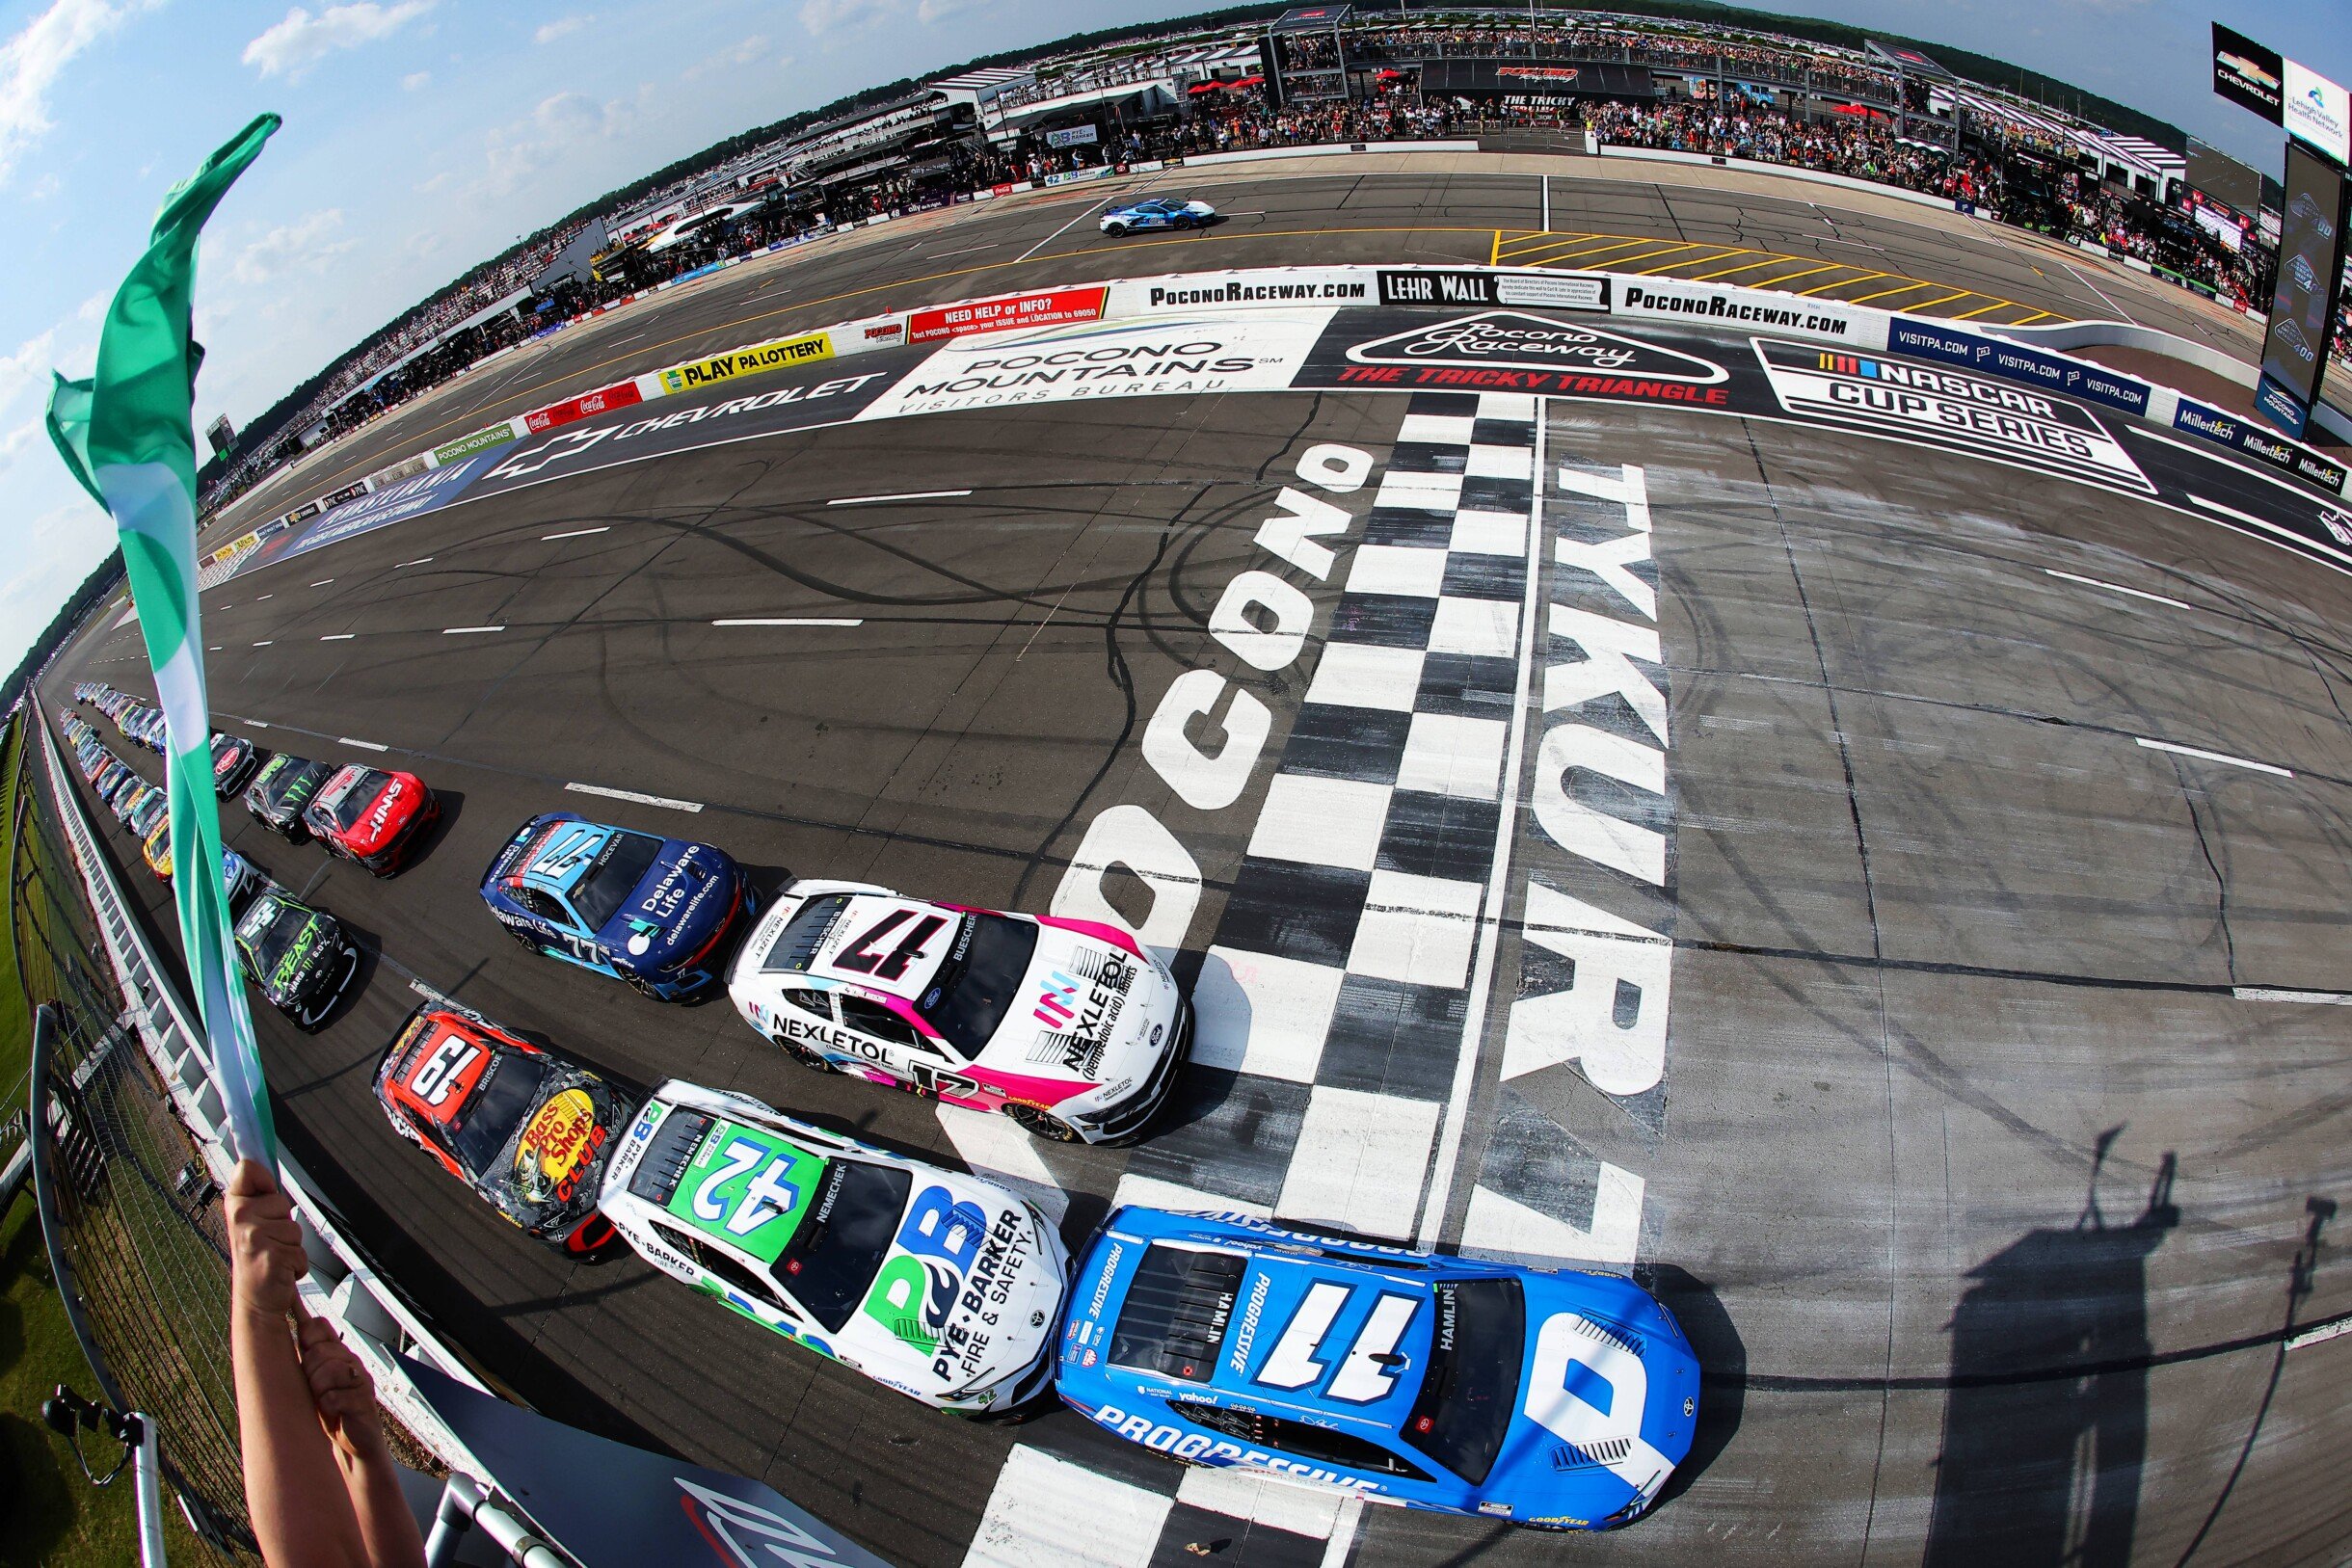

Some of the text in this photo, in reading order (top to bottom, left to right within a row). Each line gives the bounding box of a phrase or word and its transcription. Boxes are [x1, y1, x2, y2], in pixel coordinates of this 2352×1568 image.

[1504, 94, 1576, 106] THE TRICKY
[2217, 68, 2280, 107] CHEVROLET
[2287, 103, 2312, 121] Health
[2312, 115, 2343, 139] Network
[2292, 96, 2339, 128] Lehigh Valley
[1046, 175, 1060, 184] 42
[891, 208, 900, 219] 48
[2068, 234, 2080, 245] 45
[1385, 275, 1489, 302] LEHR WALL
[912, 307, 1097, 340] Text POCONO <space> your ISSUE and LOCATION to 69050
[945, 298, 1052, 324] NEED HELP or INFO?
[1404, 329, 1637, 368] Raceway
[1465, 322, 1598, 343] Pocono
[684, 357, 735, 385] PLAY
[739, 353, 761, 371] PA
[762, 339, 825, 366] LOTTERY
[962, 341, 1222, 375] POCONO
[1899, 331, 2143, 405] VISITPA.COM VISITPA.COM VISITPA.COM
[898, 379, 1225, 414] VISITORS BUREAU
[904, 358, 1255, 399] MOUNTAINS
[1337, 366, 1729, 406] THE TRICKY TRIANGLE
[1880, 362, 2057, 420] NASCAR
[529, 394, 605, 431] Coca-Cola Coca-Cola
[614, 371, 888, 441] CHEVROLET
[1830, 382, 2095, 459] CUP SERIES
[2263, 396, 2299, 425] MOUNTAINS
[2268, 393, 2295, 417] POCONO
[438, 428, 509, 462] POCONO MOUNTAINS
[599, 832, 625, 866] HOCEVAR
[641, 845, 701, 914] Delaware
[655, 887, 685, 918] Life
[666, 874, 720, 946] delawarelife.com
[533, 918, 558, 940] Life
[756, 917, 784, 958] NEXLIZET
[809, 911, 842, 955] BUESCHER
[828, 918, 852, 954] NEXLIZET
[952, 914, 977, 962] BUESCHER
[273, 914, 319, 993] BEAST
[562, 931, 601, 966] 77
[290, 970, 305, 994] HARD
[677, 968, 686, 978] 77
[924, 987, 941, 1010] Ford
[1062, 950, 1128, 1073] NEXLETOL
[773, 1013, 894, 1066] NEXLETOL
[1082, 966, 1138, 1081] (bempedoic acid) tablets
[1150, 1024, 1163, 1047] Ford
[411, 1034, 481, 1106] 19
[477, 1052, 503, 1092] BRISCOE
[908, 1059, 980, 1100] 17
[1103, 1076, 1133, 1097] NEXLETOL
[1007, 1096, 1053, 1110] GOODYEAR
[524, 1103, 558, 1151] Bass
[539, 1120, 566, 1156] Pro
[551, 1107, 593, 1167] Shops
[556, 1123, 607, 1203] CLUB
[613, 1138, 636, 1182] BARKER
[668, 1133, 704, 1187] NEMECHEK
[692, 1135, 801, 1239] 42
[816, 1161, 847, 1224] NEMECHEK
[555, 1228, 566, 1241] 19
[1088, 1241, 1124, 1320] PROGRESSIVE
[960, 1232, 1034, 1379] FIRE & SAFETY
[1207, 1291, 1234, 1344] HAMLIN
[1230, 1271, 1271, 1376] PROGRESSIVE
[1440, 1289, 1456, 1351] HAMLIN
[1253, 1280, 1422, 1404] 11
[872, 1374, 922, 1396] GOODYEAR
[977, 1388, 998, 1405] 42
[1146, 1387, 1173, 1395] NATIONAL
[1179, 1392, 1218, 1405] yahoo!
[1528, 1515, 1590, 1527] GOODYEAR
